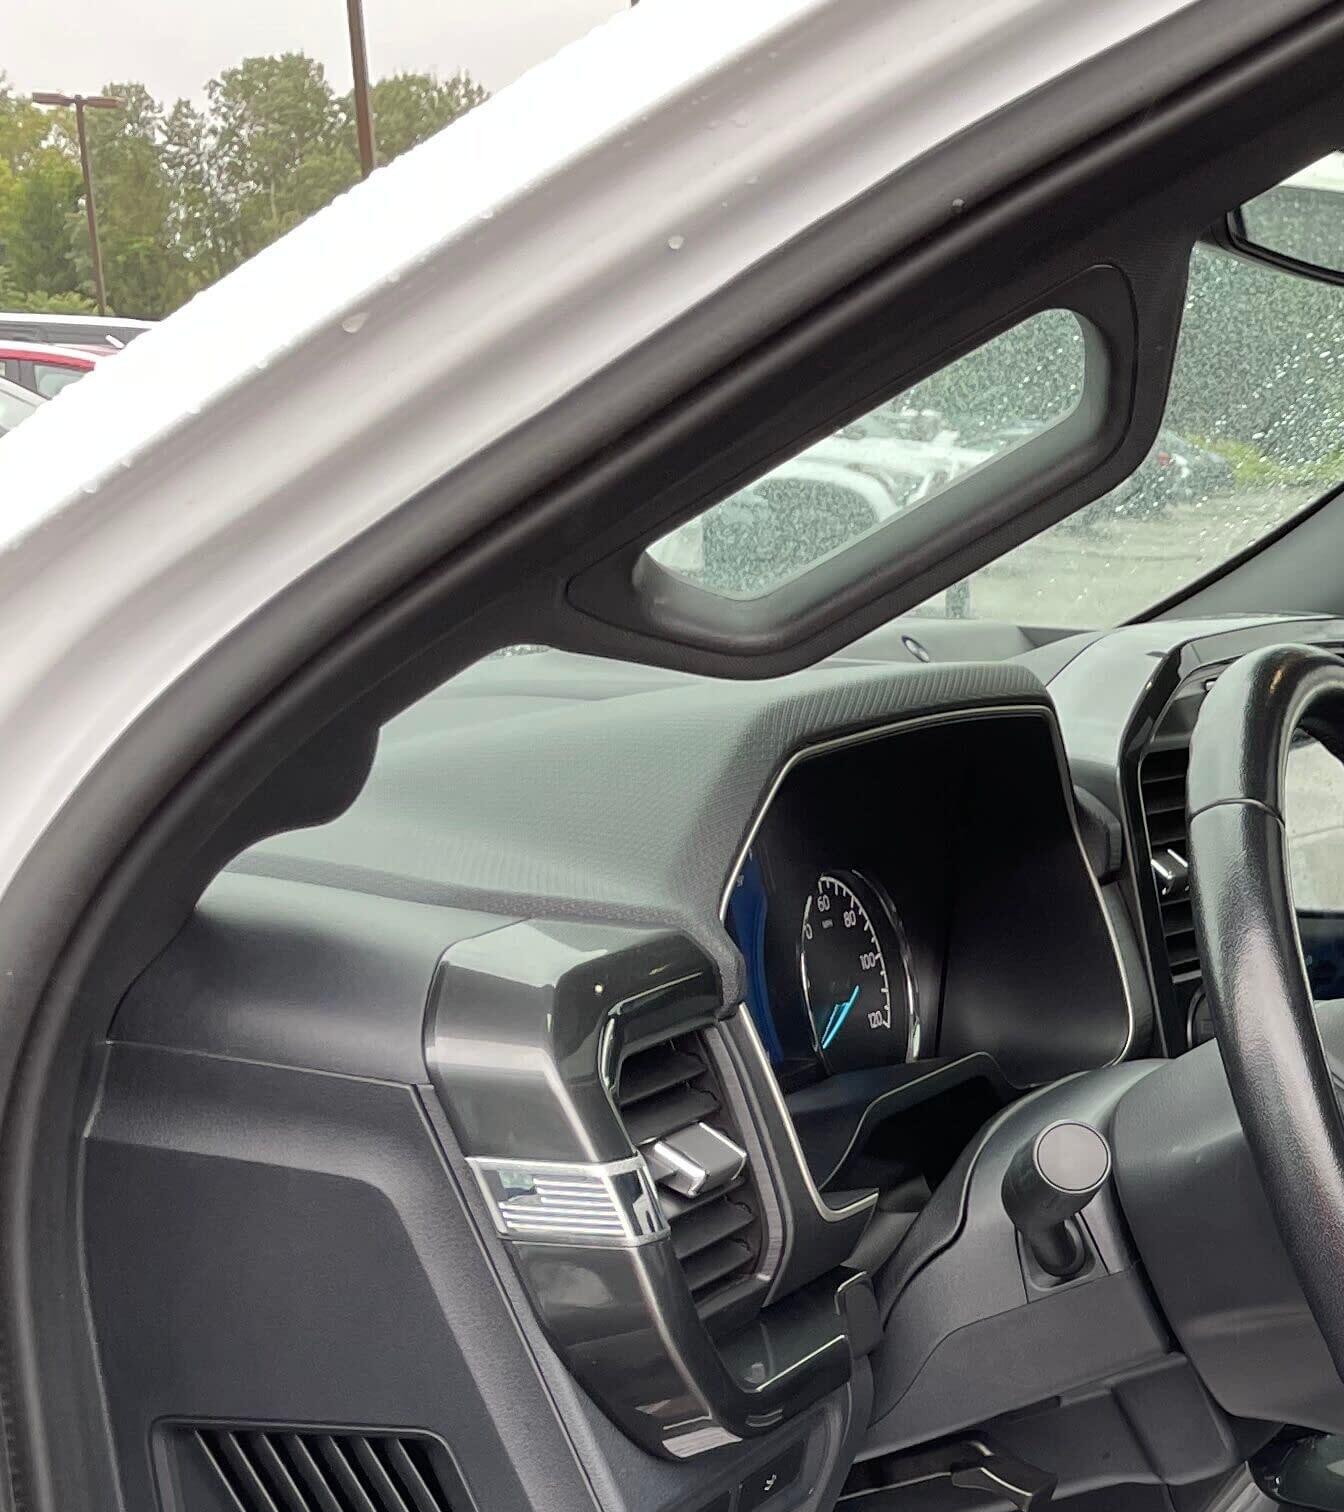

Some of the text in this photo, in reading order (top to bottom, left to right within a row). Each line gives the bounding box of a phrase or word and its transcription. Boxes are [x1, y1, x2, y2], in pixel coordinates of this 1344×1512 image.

[817, 894, 831, 912] 60
[843, 909, 857, 928] 80
[859, 951, 876, 970] 100
[868, 1010, 883, 1029] 120
